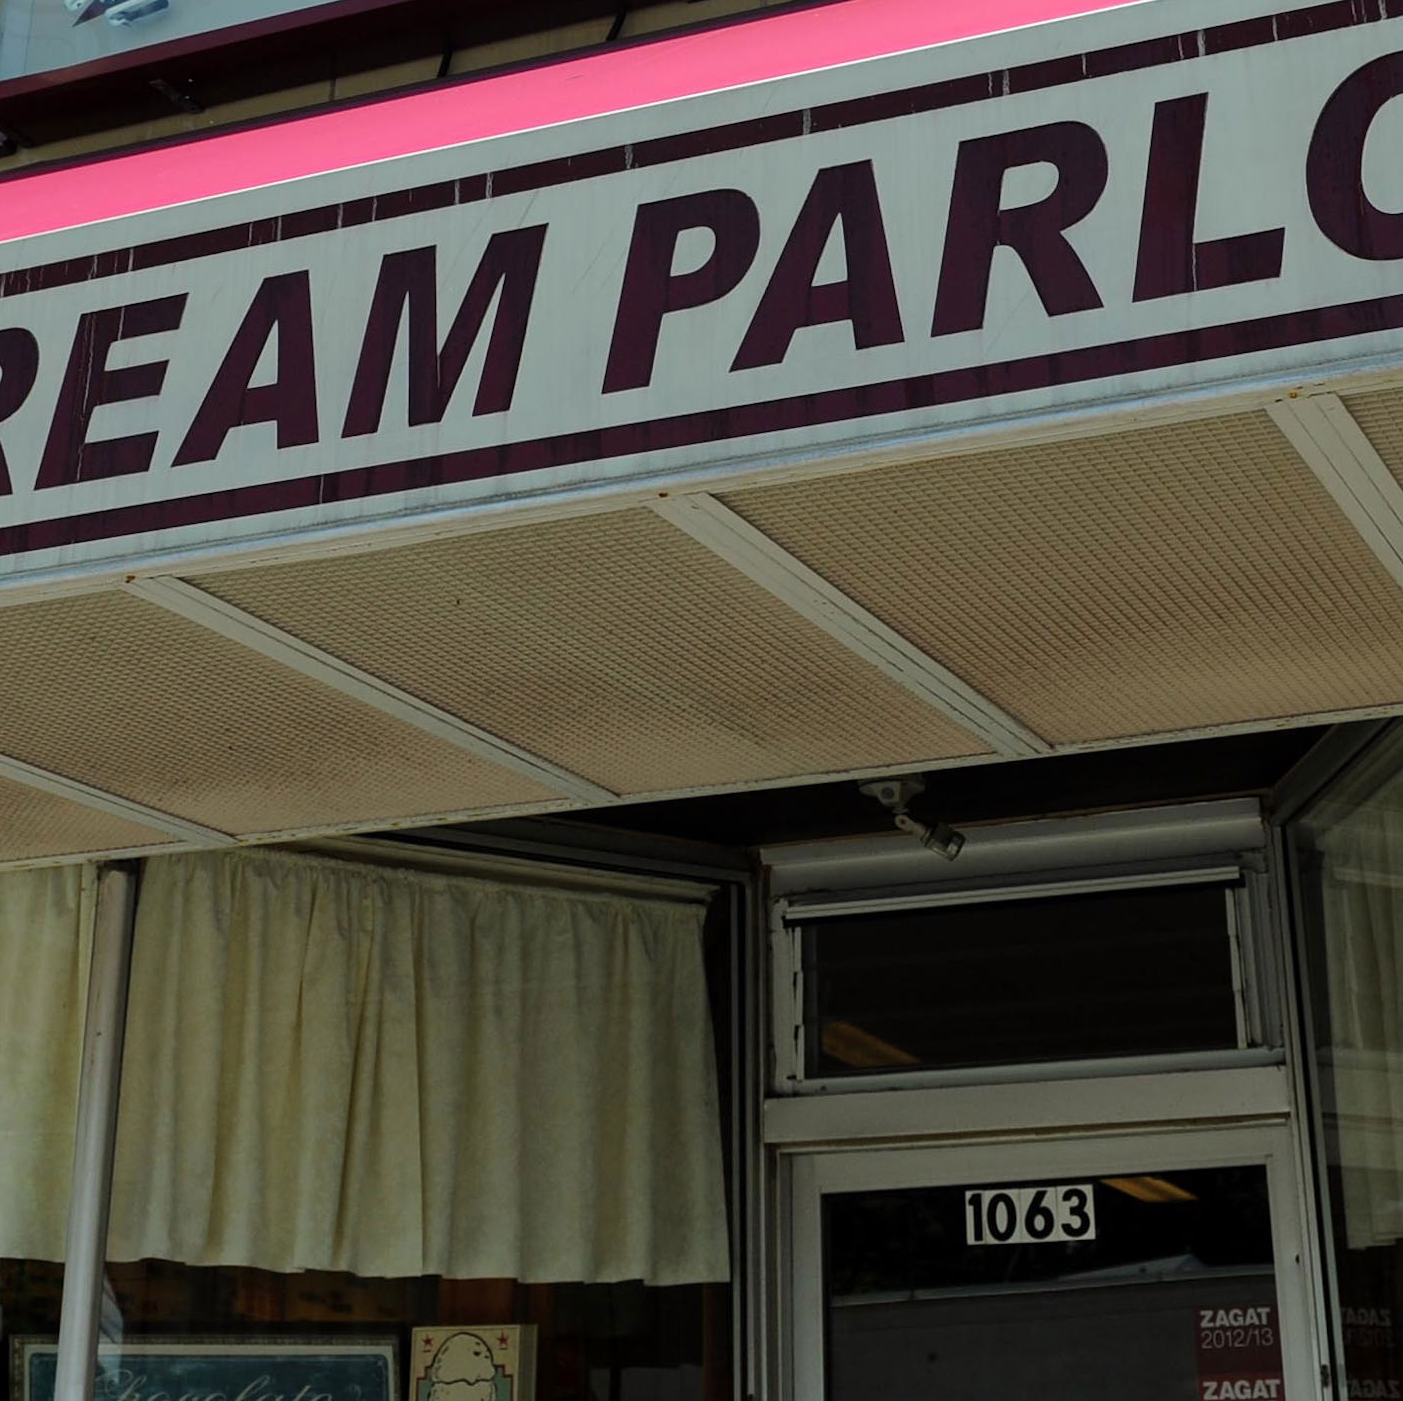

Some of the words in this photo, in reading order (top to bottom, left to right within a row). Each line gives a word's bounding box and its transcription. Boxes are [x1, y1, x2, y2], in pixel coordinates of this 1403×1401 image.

[968, 1188, 1090, 1242] 1063
[1200, 1307, 1271, 1328] ZAGAT
[1201, 1328, 1274, 1349] 2012/13
[1202, 1379, 1281, 1401] ZAGAT
